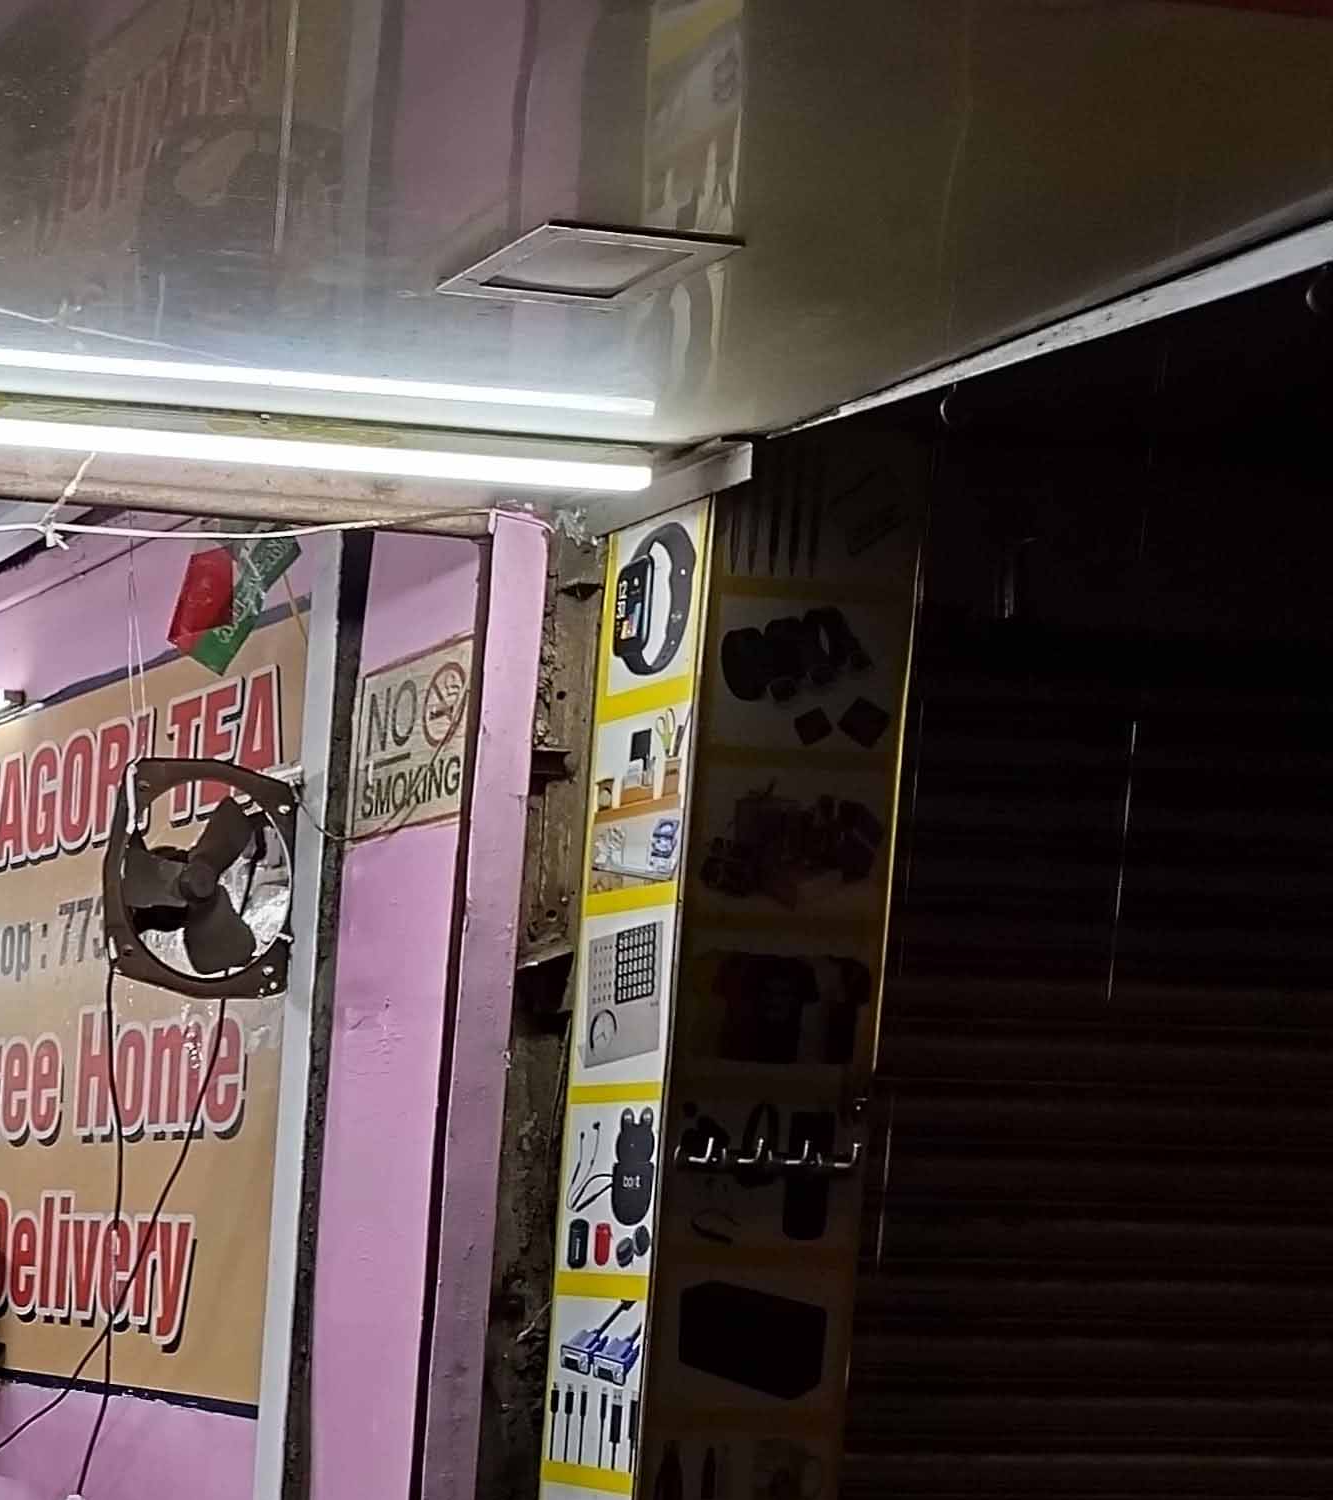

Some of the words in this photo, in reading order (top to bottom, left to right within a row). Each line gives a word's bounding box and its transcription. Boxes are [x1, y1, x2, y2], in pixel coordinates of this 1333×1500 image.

[167, 664, 282, 826] TEA
[366, 680, 417, 756] NO
[362, 756, 461, 819] SMOKING
[75, 1001, 246, 1144] Home
